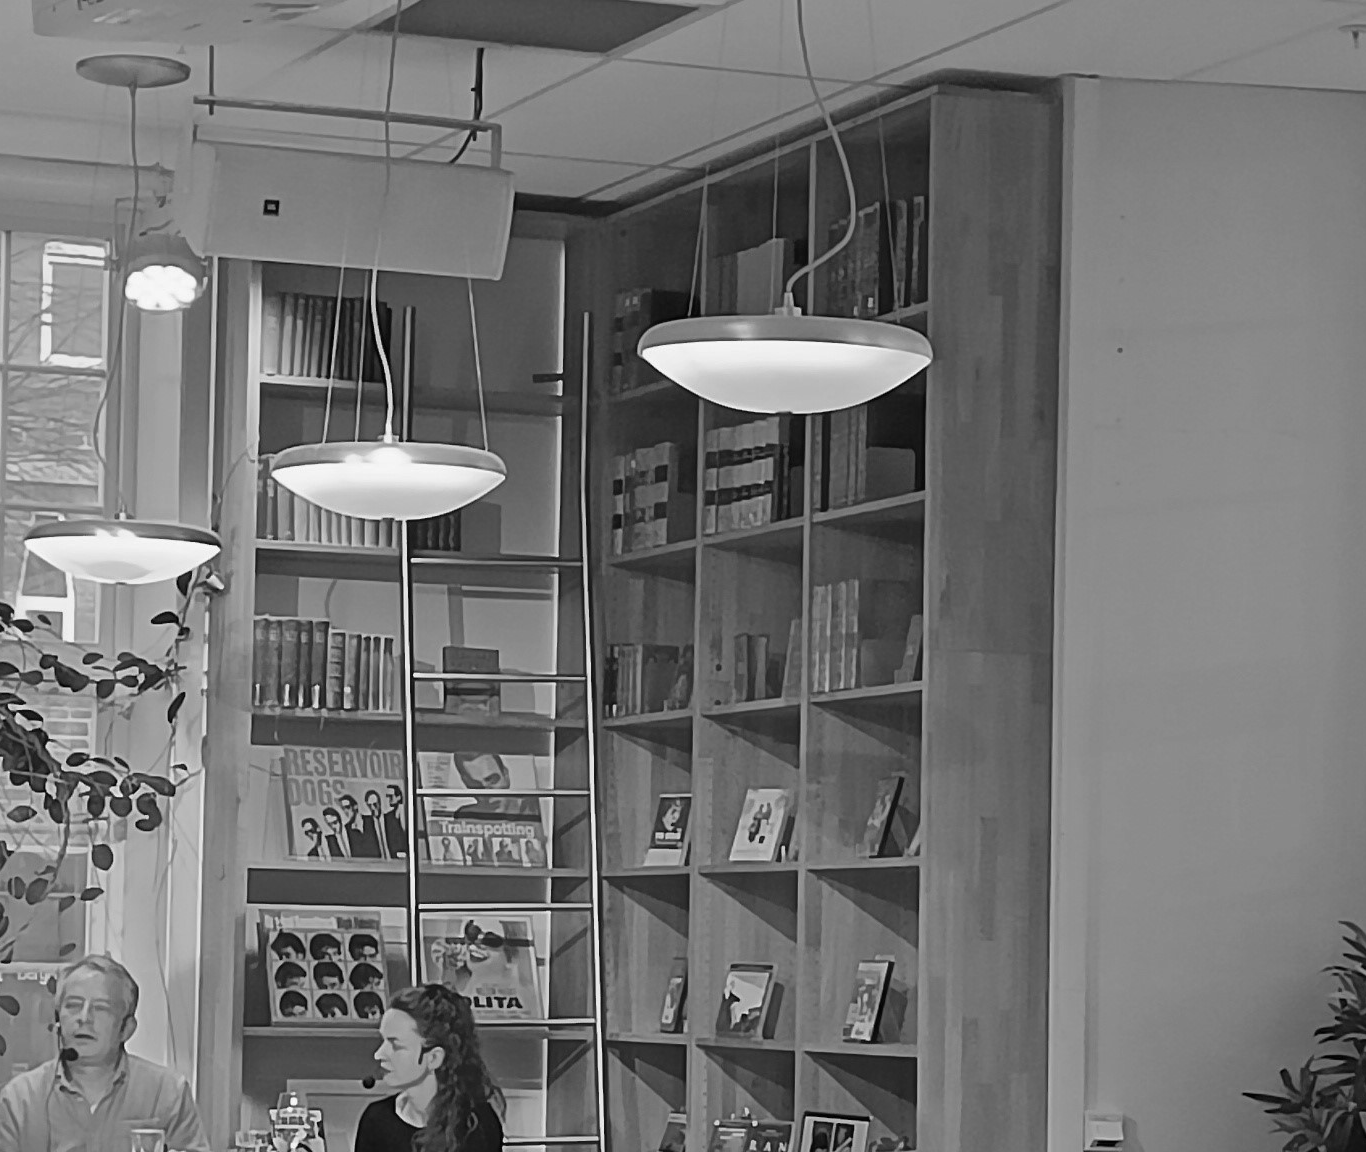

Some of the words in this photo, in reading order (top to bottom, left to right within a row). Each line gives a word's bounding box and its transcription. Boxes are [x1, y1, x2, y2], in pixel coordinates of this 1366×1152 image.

[283, 747, 403, 780] RESERVOIR
[287, 777, 346, 806] DOGS
[438, 820, 535, 839] Trainspotting
